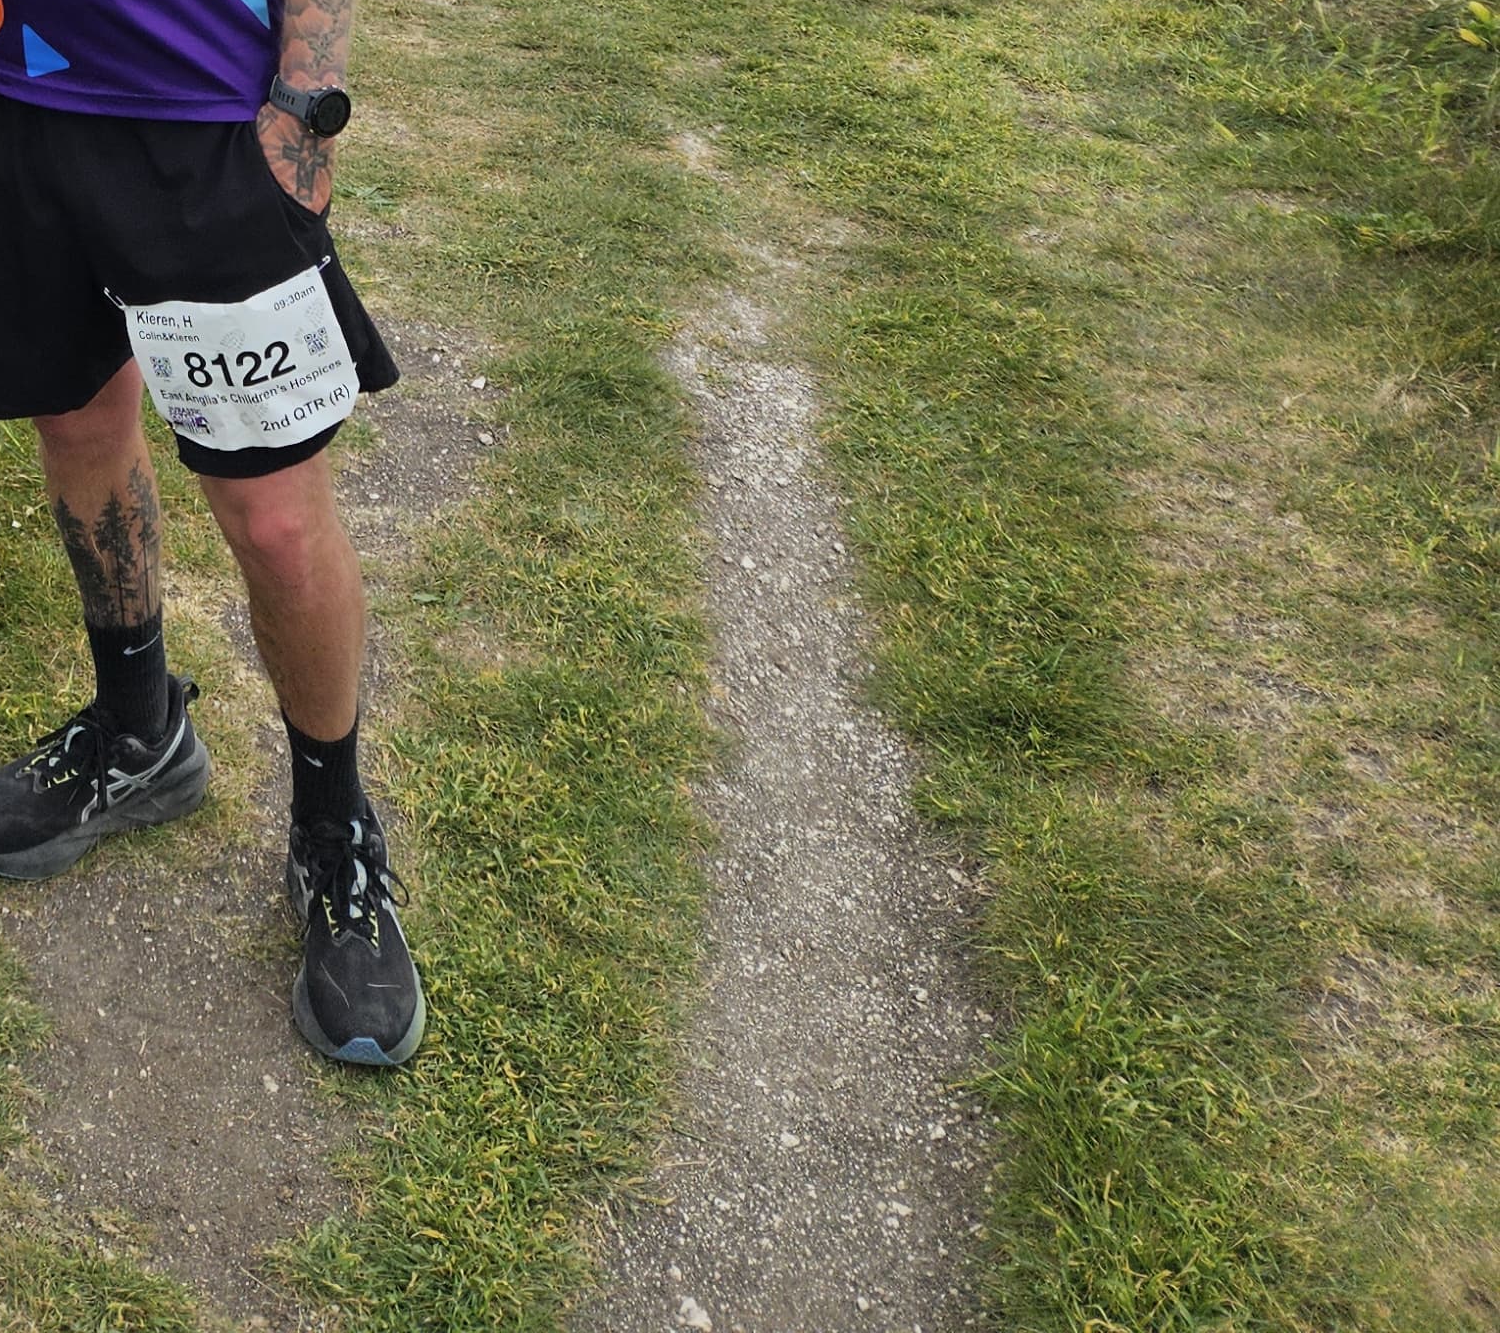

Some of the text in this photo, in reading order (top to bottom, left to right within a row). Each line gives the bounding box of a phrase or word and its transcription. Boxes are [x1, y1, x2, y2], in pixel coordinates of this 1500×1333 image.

[273, 285, 316, 311] 09:30am
[136, 310, 193, 329] Kieren, H
[138, 330, 200, 342] Colin&Kieren
[184, 340, 296, 388] 8122
[160, 359, 342, 407] East Anglia's Children's Hospices
[260, 383, 350, 432] 2nd QTR (R)
